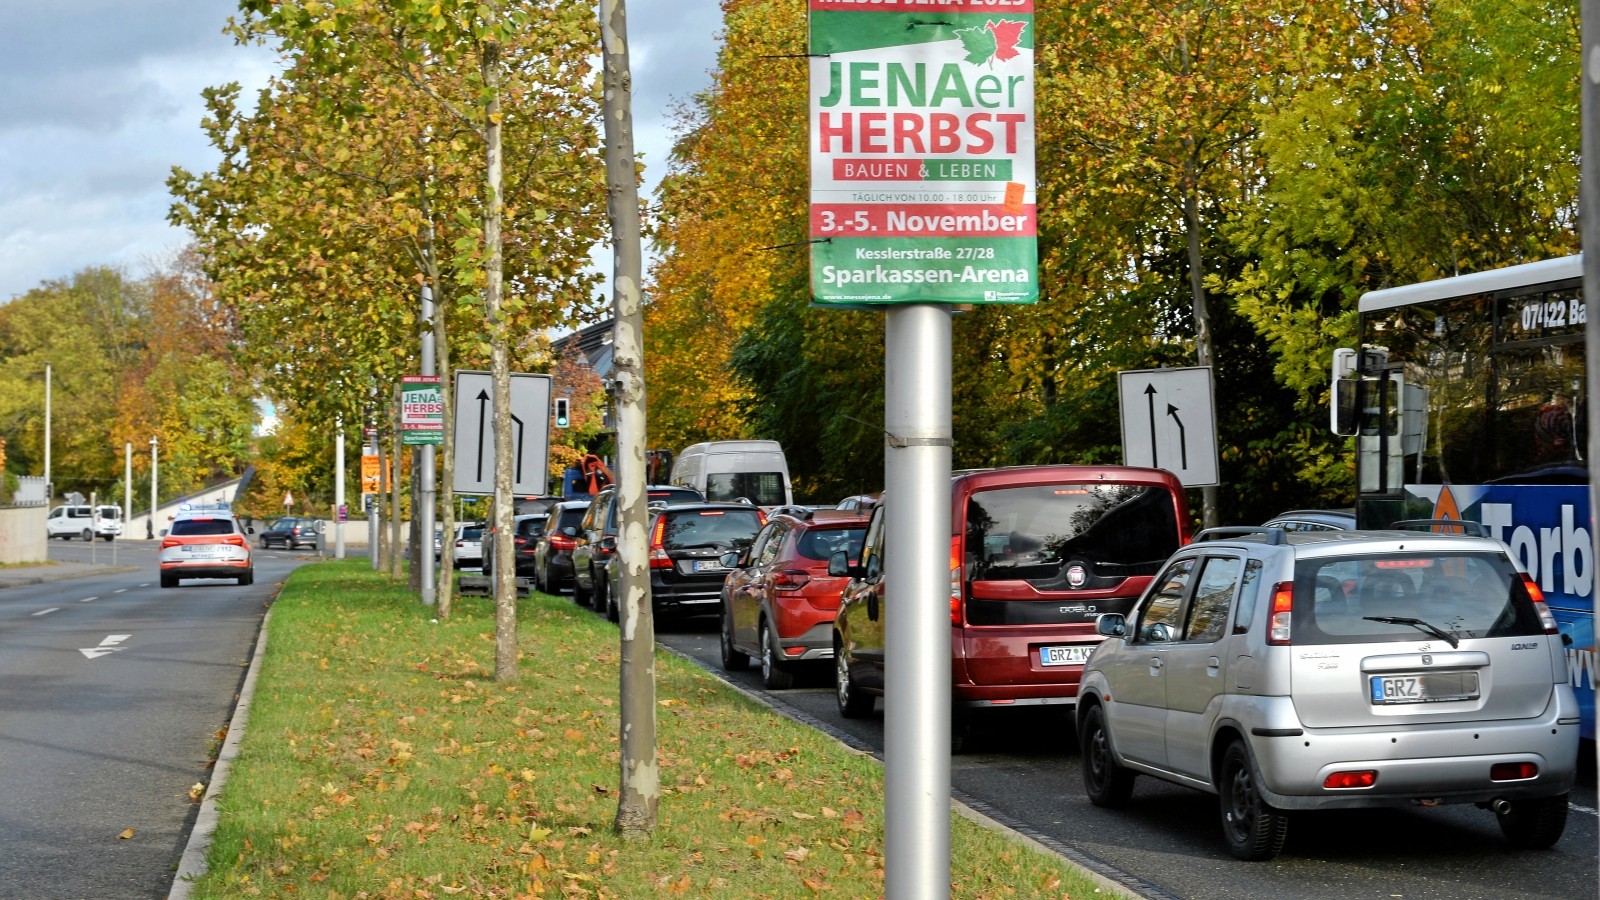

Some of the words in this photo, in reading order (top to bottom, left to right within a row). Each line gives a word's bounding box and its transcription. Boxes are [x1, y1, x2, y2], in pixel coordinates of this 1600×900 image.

[819, 62, 1025, 108] JENAer
[819, 112, 1026, 154] HERBST
[845, 164, 908, 177] BAUEN
[918, 164, 930, 177] &
[940, 164, 996, 177] LEBEN
[852, 192, 892, 201] TÄGLICH
[895, 193, 915, 201] VON
[919, 193, 943, 202] 10.00
[953, 193, 977, 202] 18.00
[980, 193, 996, 202] Uhr
[820, 211, 877, 232] 3.-5.
[887, 210, 1028, 232] November
[856, 247, 952, 260] Kesslerstraße
[956, 248, 995, 260] 27/28
[822, 265, 1029, 287] Sparkassen-Arena
[1522, 300, 1566, 330] 07422
[1049, 649, 1072, 661] GRZ
[1383, 678, 1418, 697] GRZ
